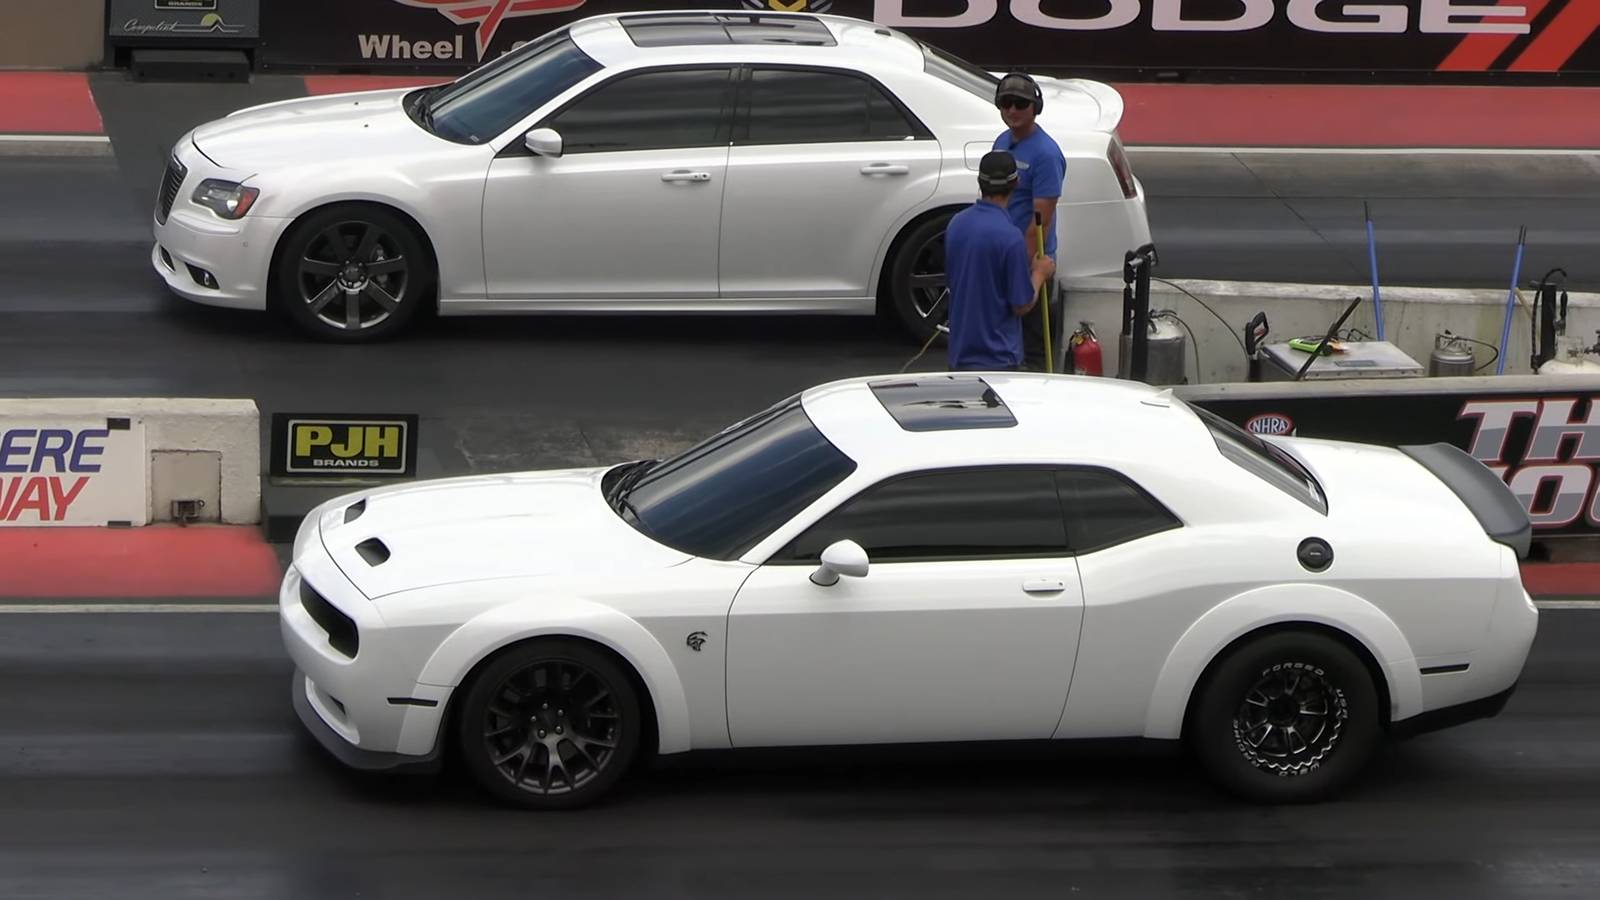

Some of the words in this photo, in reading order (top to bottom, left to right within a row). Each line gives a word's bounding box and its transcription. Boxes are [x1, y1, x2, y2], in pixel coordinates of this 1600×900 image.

[873, 0, 1531, 34] DODGE
[358, 34, 463, 60] Wheel
[1252, 417, 1287, 433] NHRA
[0, 429, 110, 473] ERE
[295, 425, 400, 458] PJH
[312, 459, 379, 467] BRANDS
[1262, 662, 1325, 677] FORGED
